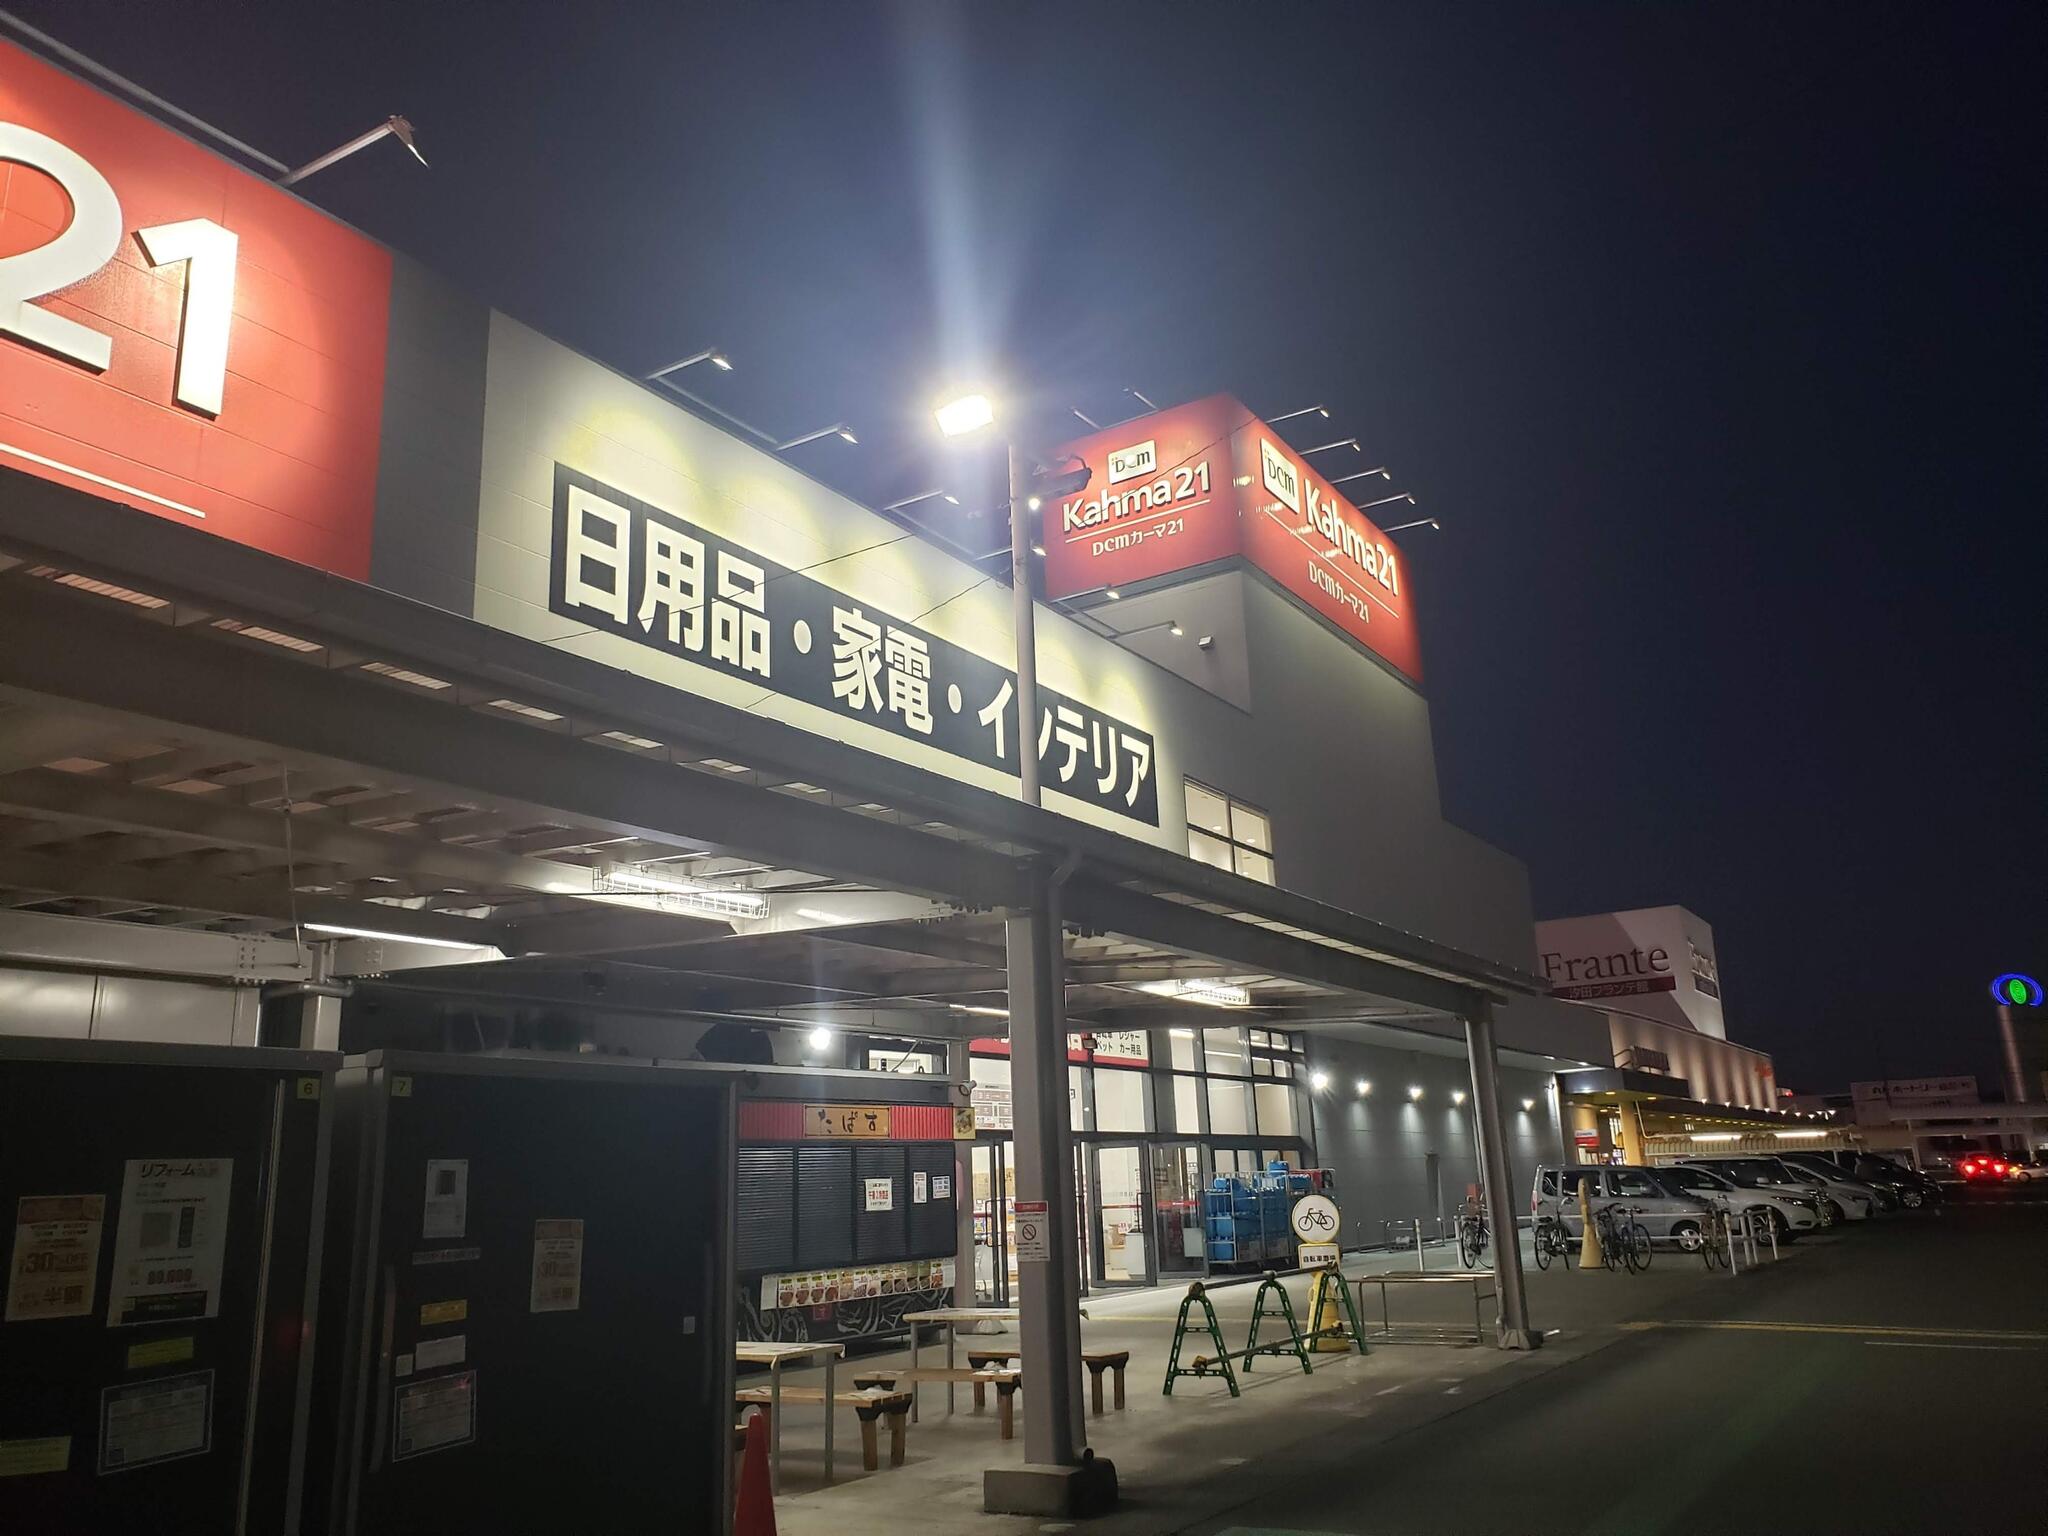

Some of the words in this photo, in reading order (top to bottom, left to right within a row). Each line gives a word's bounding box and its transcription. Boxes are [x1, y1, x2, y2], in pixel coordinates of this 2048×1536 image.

[0, 120, 239, 420] 21
[1541, 943, 1671, 985] Frante
[303, 1082, 314, 1096] 6
[398, 1080, 408, 1095] 7
